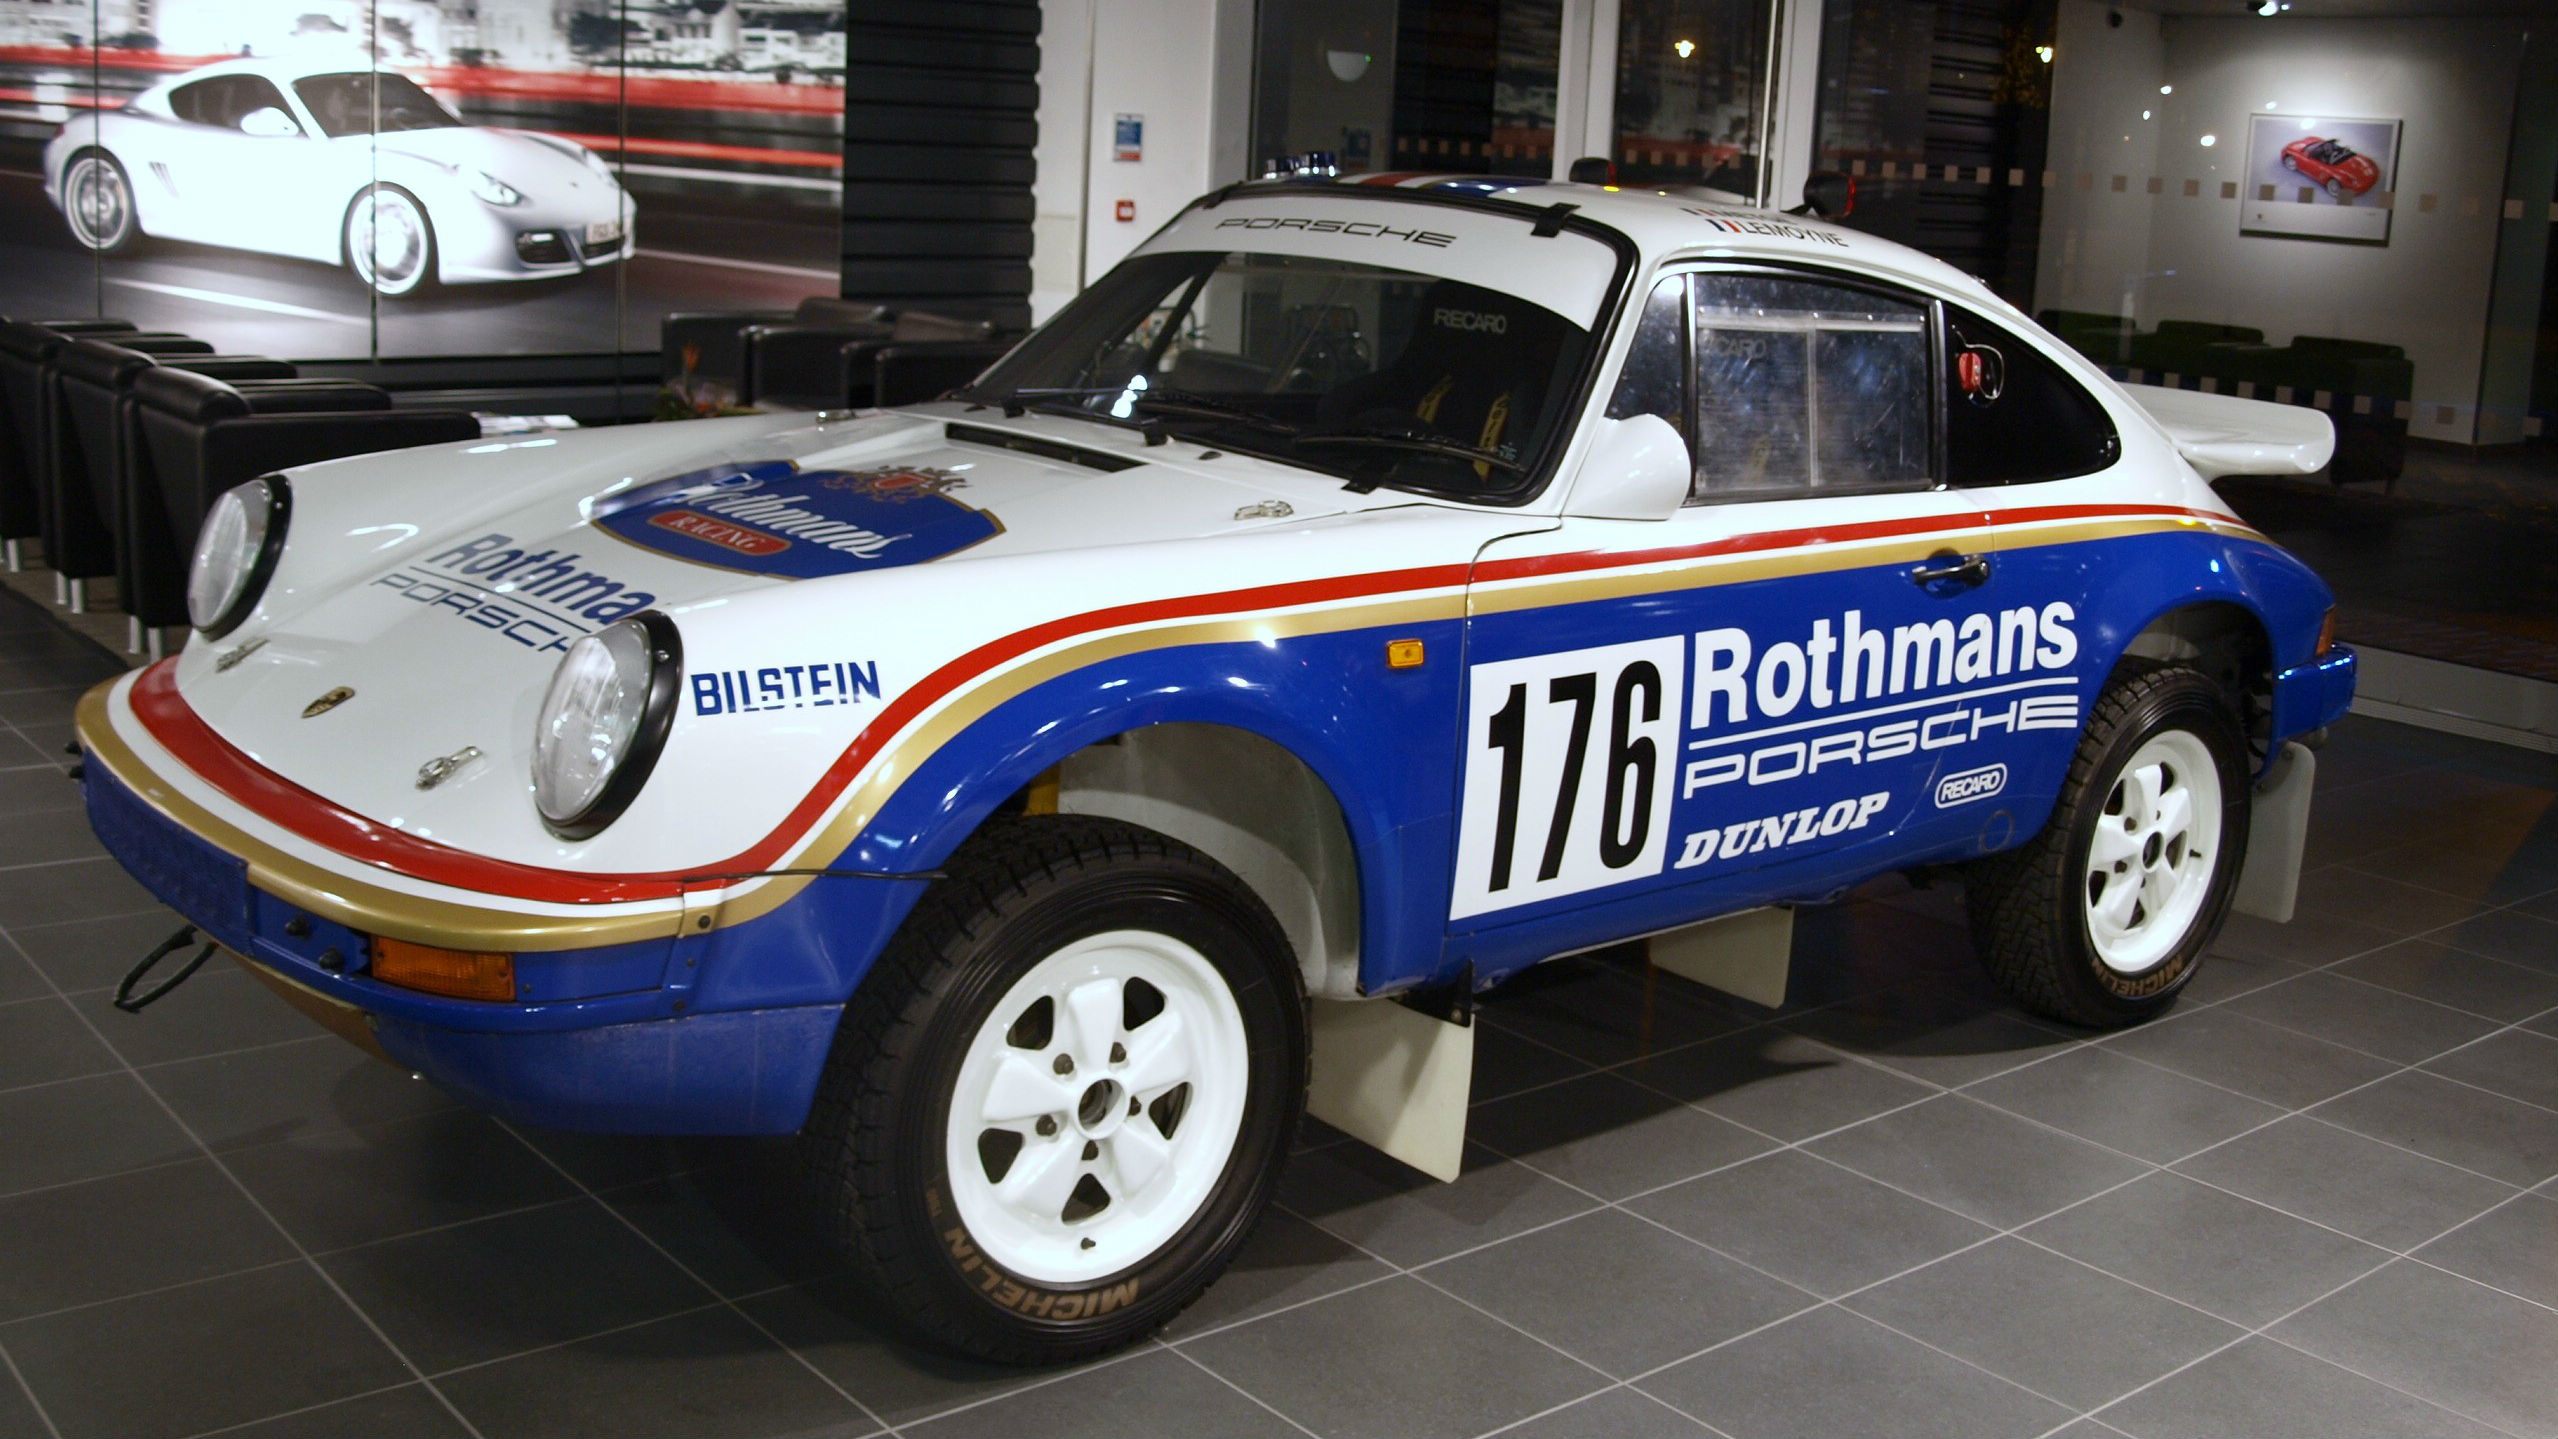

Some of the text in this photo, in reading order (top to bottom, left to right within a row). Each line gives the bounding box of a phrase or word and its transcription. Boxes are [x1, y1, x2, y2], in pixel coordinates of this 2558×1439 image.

[1215, 218, 1457, 248] PORSCHE
[1734, 211, 1849, 248] LEMOYNE
[1434, 308, 1508, 335] RECARO
[668, 514, 766, 550] RACING
[679, 473, 913, 559] Rothmans
[370, 573, 573, 652] PORSCH
[425, 533, 656, 626] Rothma
[691, 661, 881, 716] BILSTEIN
[1690, 601, 2079, 730] Rothmans
[1488, 660, 1662, 893] 176
[1683, 695, 2079, 799] PORSCHE
[1941, 770, 2001, 802] RECARO
[1674, 791, 1890, 869] DUNLOP
[2090, 953, 2186, 997] MICHELIN
[944, 1226, 1141, 1321] MICHELIN
